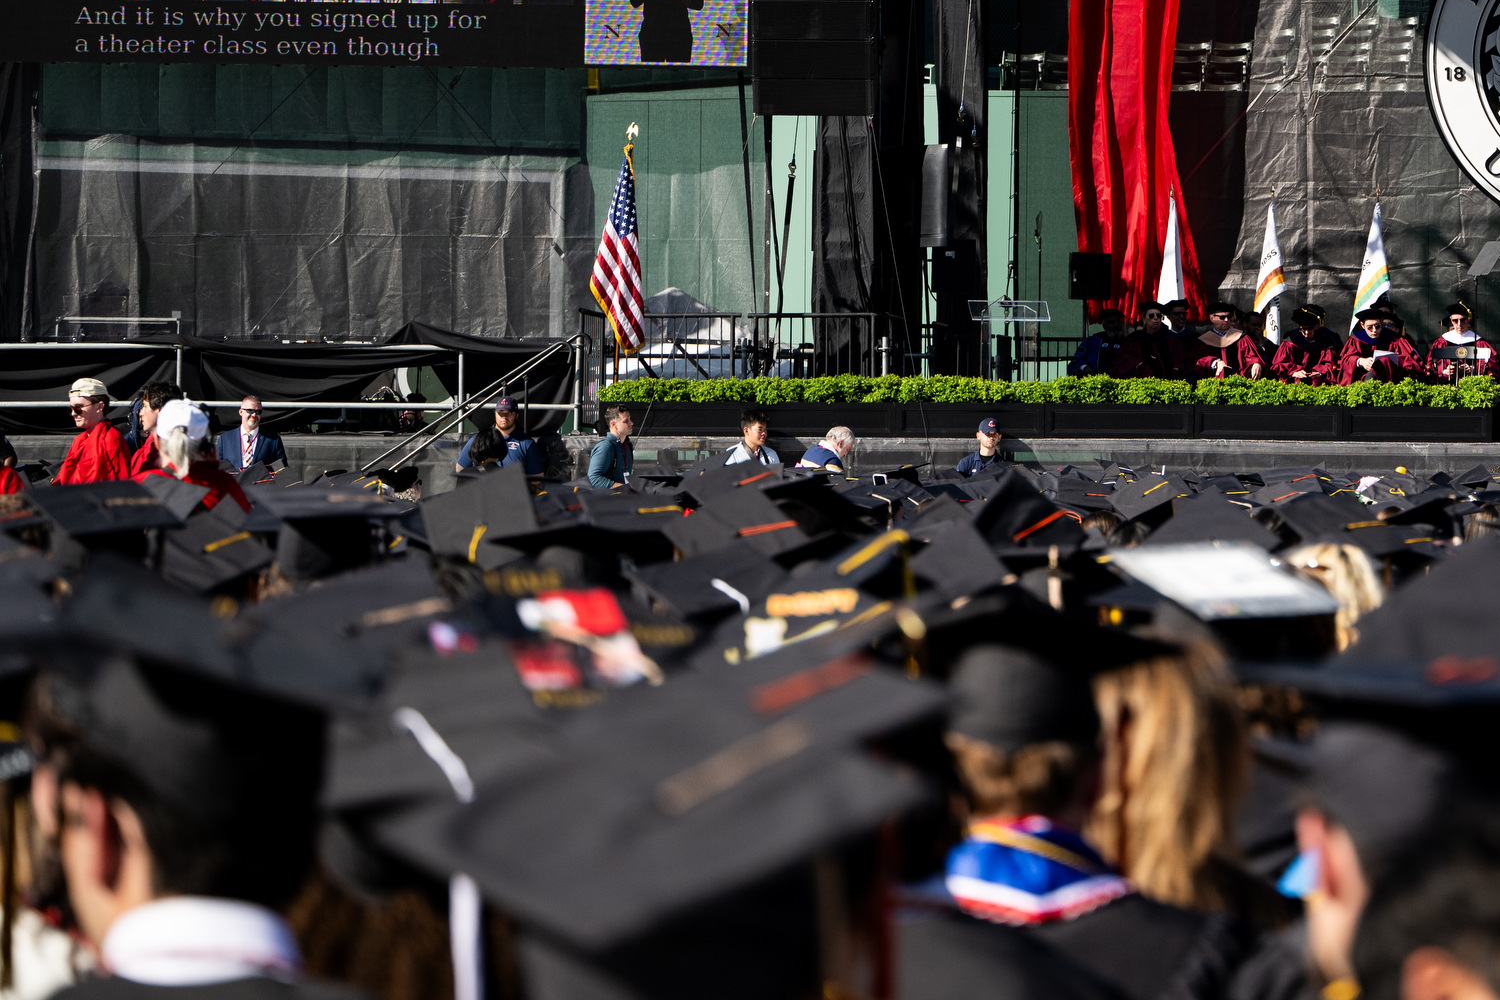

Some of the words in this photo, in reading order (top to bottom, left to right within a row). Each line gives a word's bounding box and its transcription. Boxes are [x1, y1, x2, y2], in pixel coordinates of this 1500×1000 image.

[75, 6, 126, 25] And
[136, 7, 154, 25] it
[164, 7, 184, 25] is
[193, 7, 247, 31] why
[255, 13, 301, 31] you
[311, 9, 398, 32] signed
[407, 15, 439, 33] up
[448, 10, 487, 29] for
[75, 39, 89, 53] a
[99, 34, 195, 54] theater
[204, 35, 267, 55] class
[277, 41, 338, 55] even
[347, 36, 440, 62] though
[1444, 67, 1466, 82] 18
